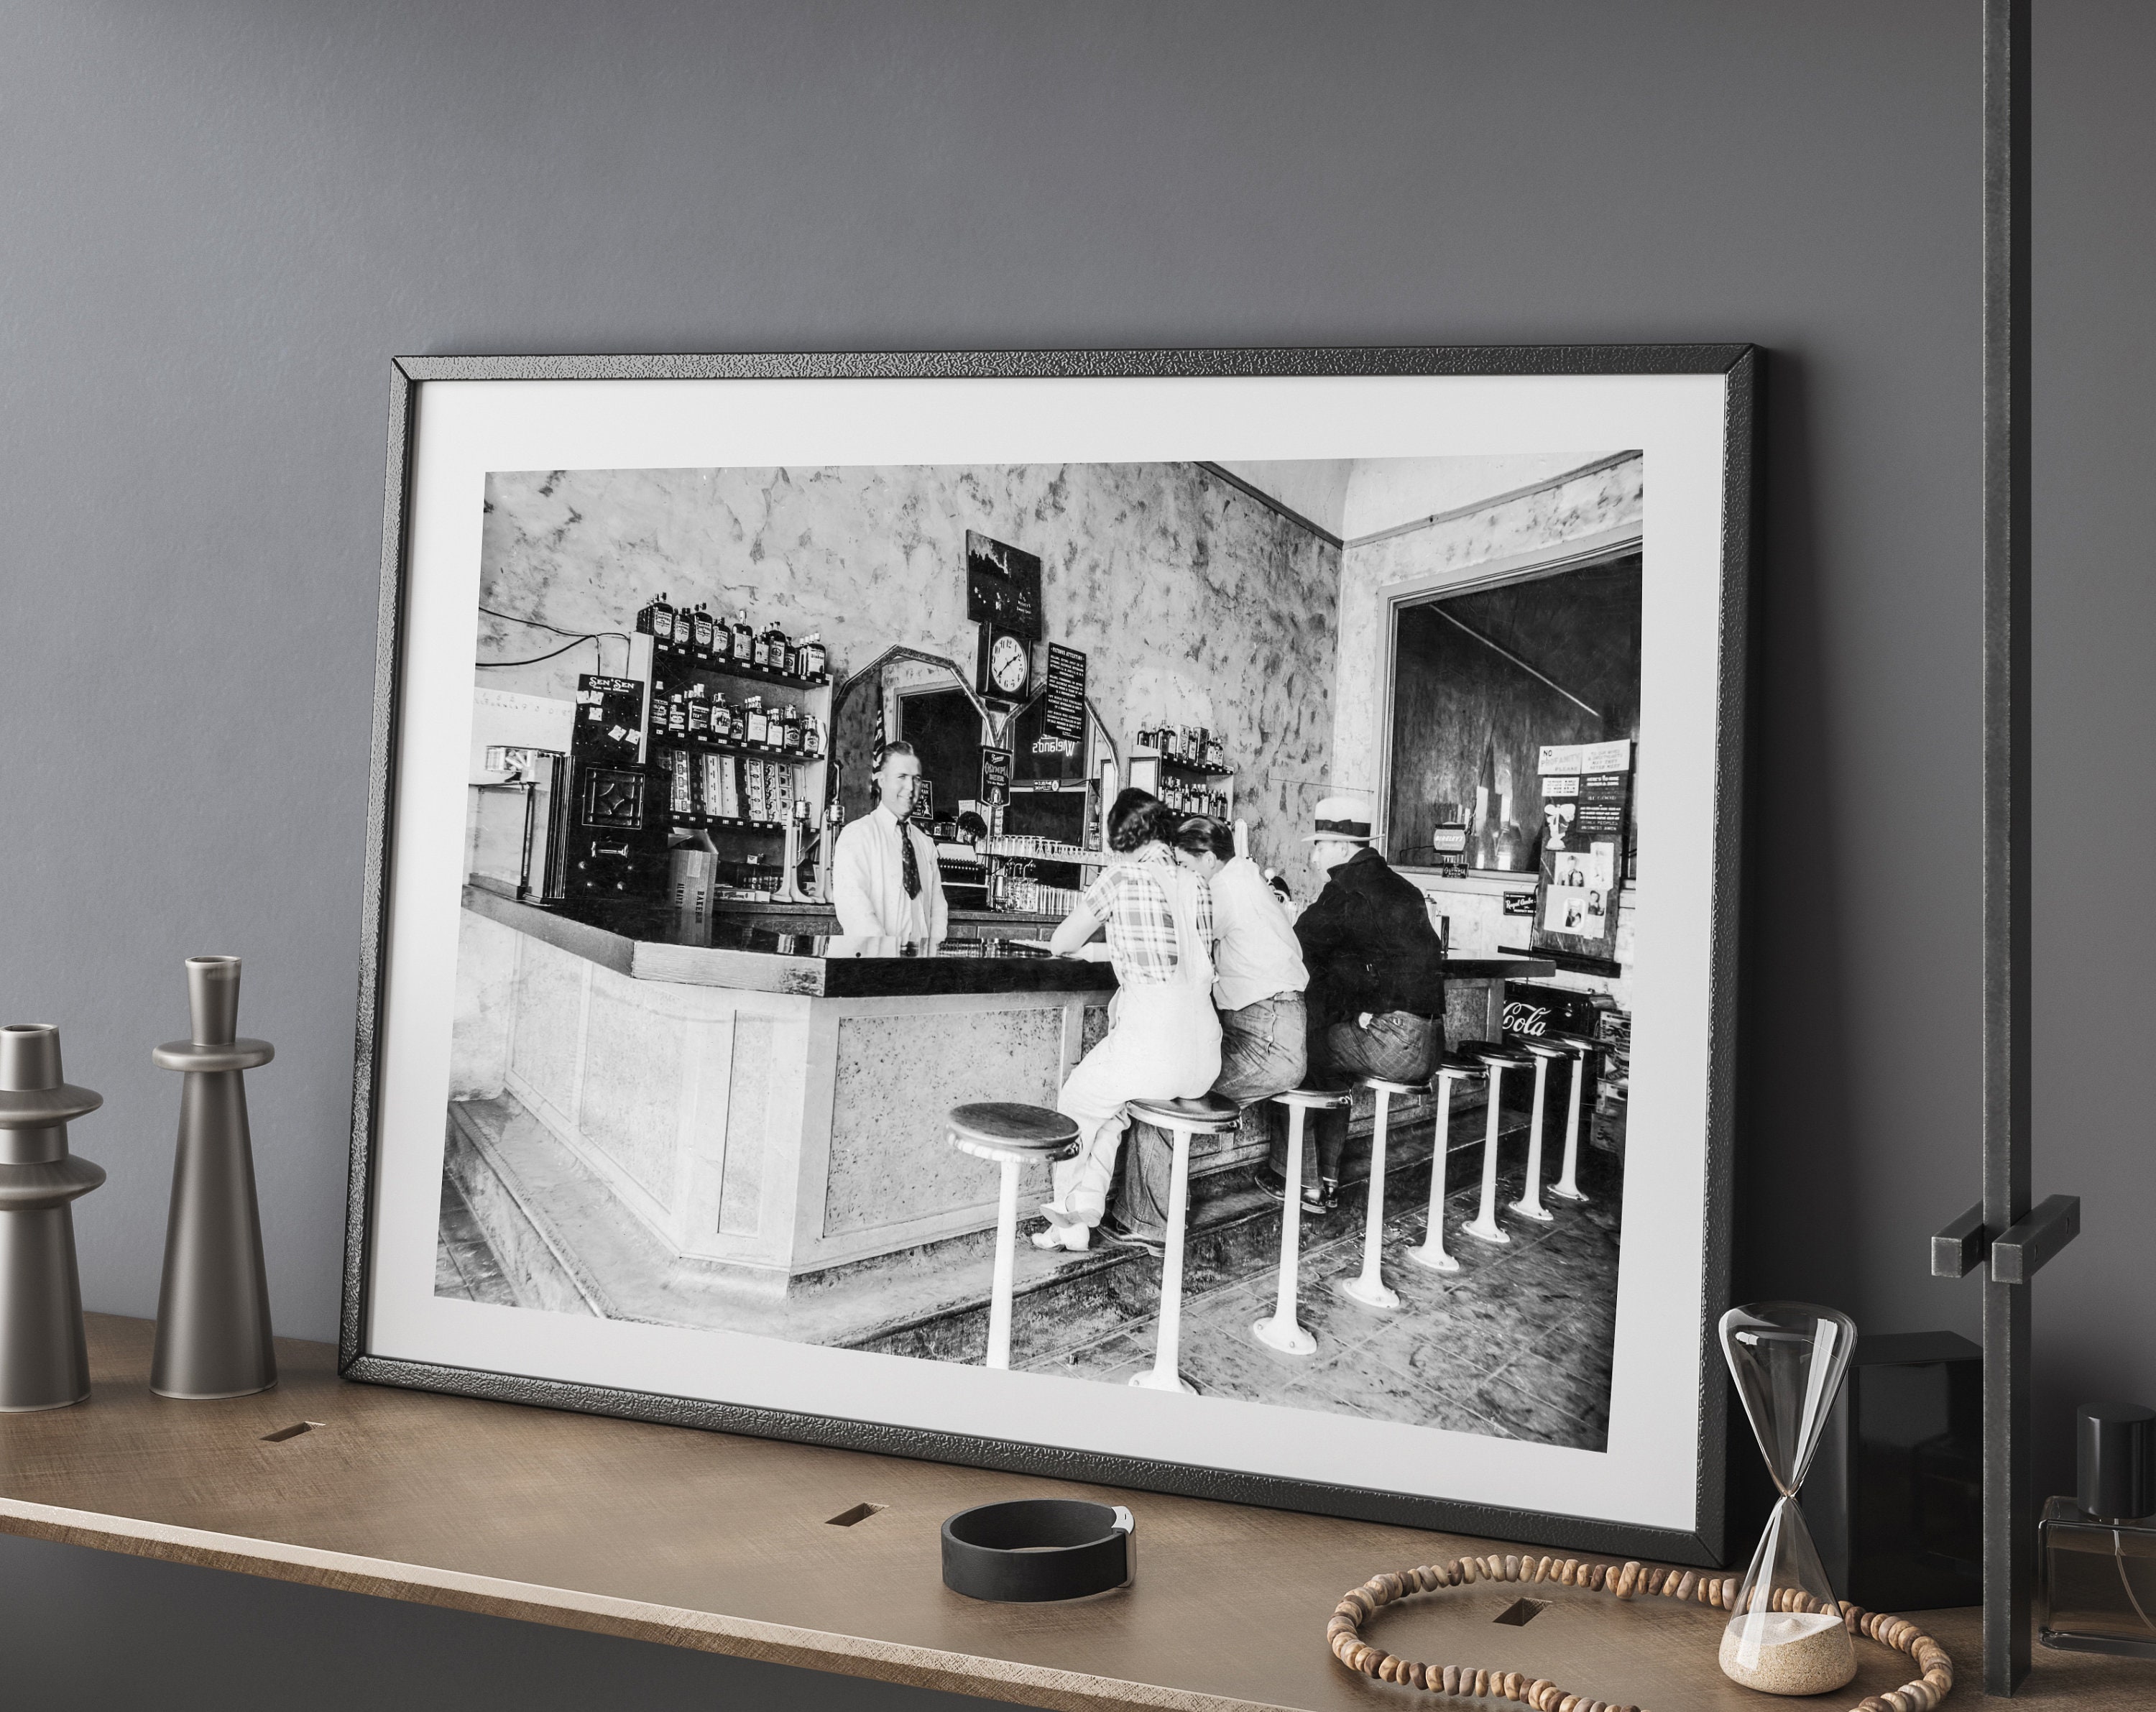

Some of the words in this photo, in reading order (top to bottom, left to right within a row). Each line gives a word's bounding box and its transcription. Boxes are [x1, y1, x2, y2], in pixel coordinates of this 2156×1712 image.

[1006, 639, 1012, 648] 12
[995, 645, 1000, 654] 10
[985, 761, 1009, 778] OLYMPIA
[989, 773, 1005, 782] BEER
[1502, 1002, 1552, 1036] Cola
